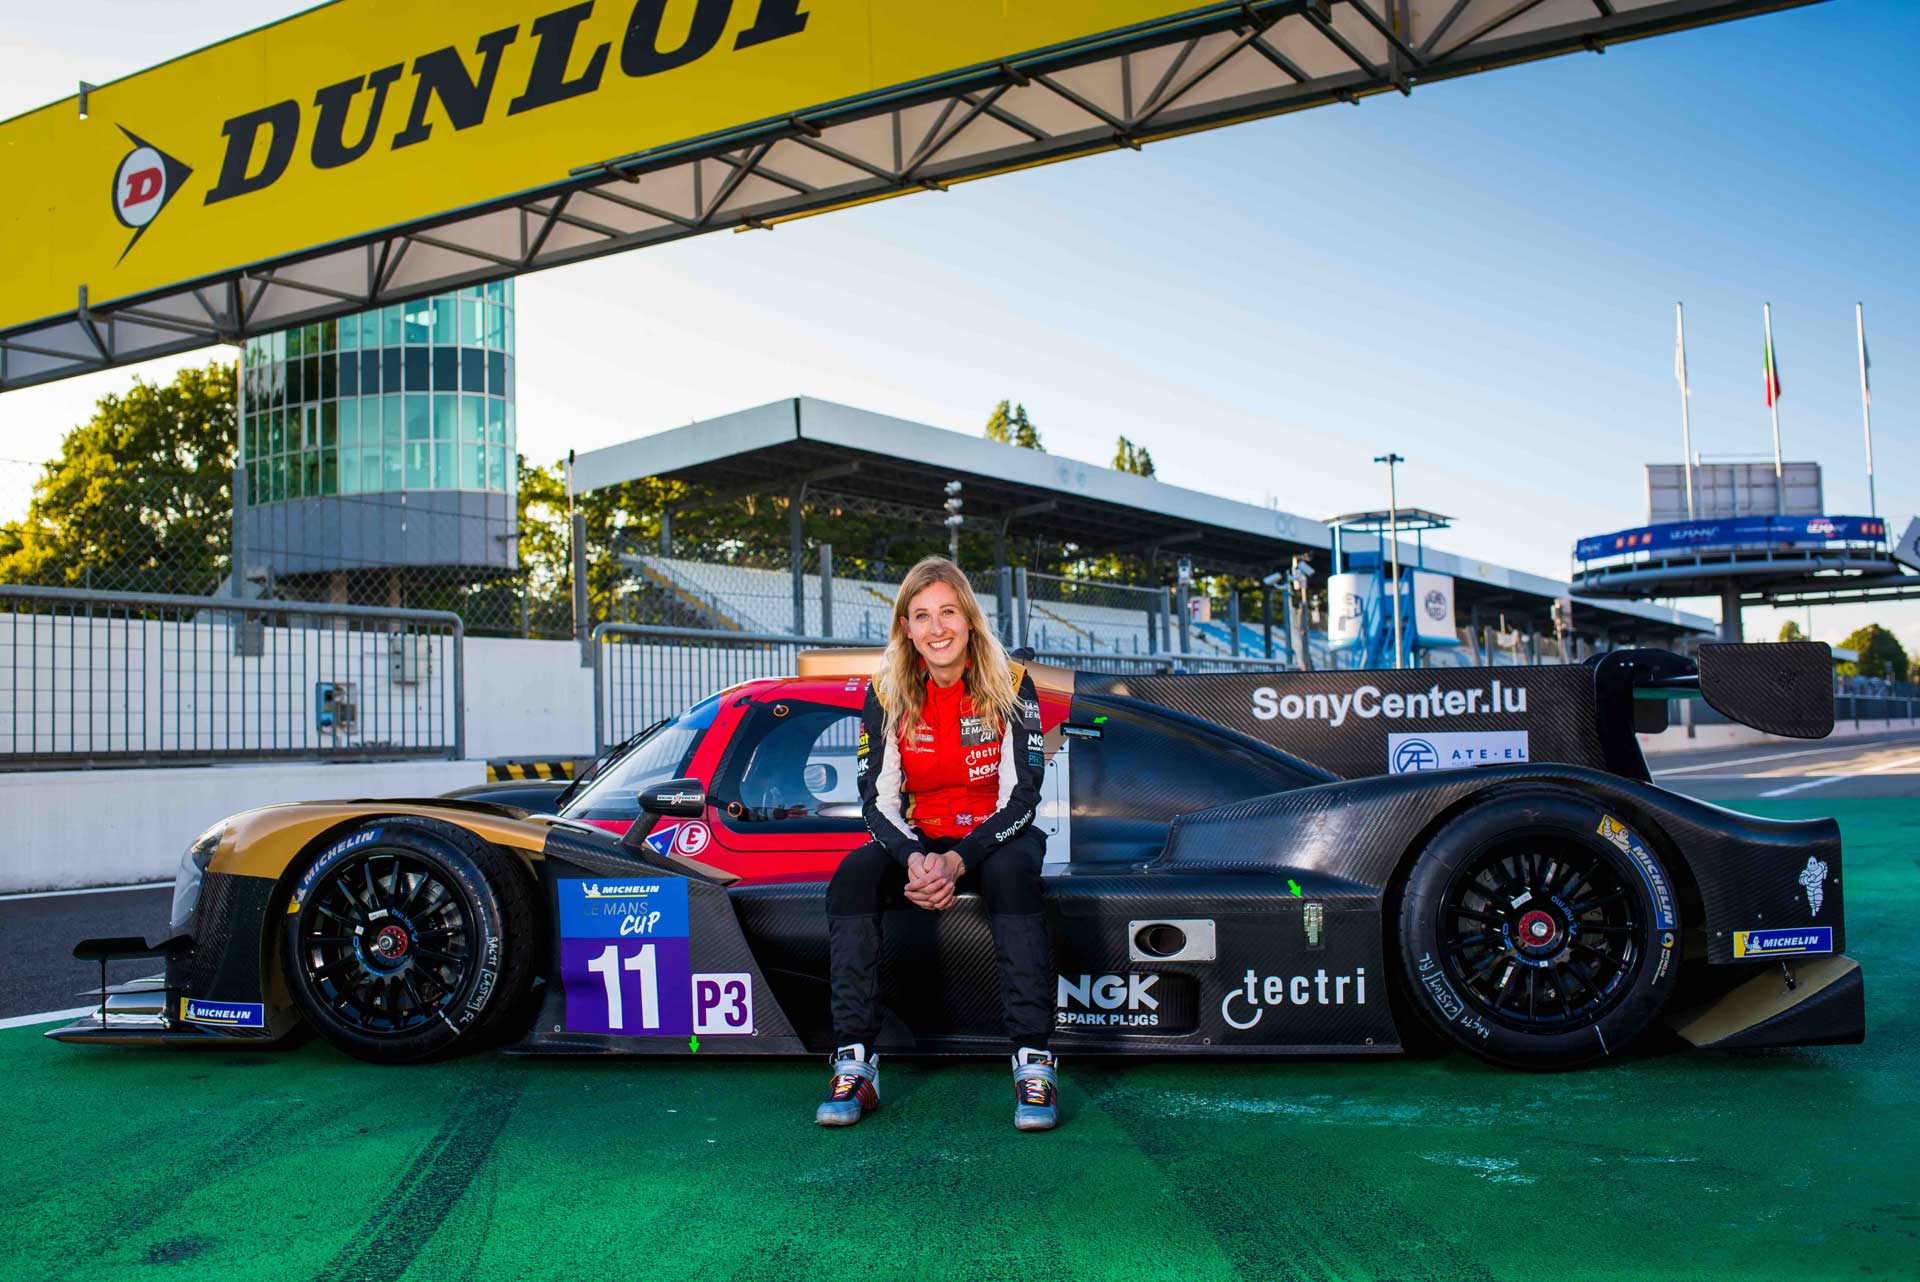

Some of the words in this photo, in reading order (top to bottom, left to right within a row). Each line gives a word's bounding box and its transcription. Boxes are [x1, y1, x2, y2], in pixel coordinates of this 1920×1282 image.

[123, 167, 163, 208] D
[1252, 680, 1527, 727] SonyCenter.lu
[961, 727, 971, 736] LE
[1027, 733, 1044, 747] NG
[968, 760, 999, 779] NGK
[304, 831, 376, 885] MICHELIN
[602, 885, 660, 895] MICHELIN
[1632, 845, 1674, 926] MICHELIN
[583, 901, 601, 916] LE
[603, 901, 649, 916] MANS
[620, 911, 661, 936] CUP
[1762, 935, 1819, 948] MICHELIN
[588, 943, 660, 1029] 11
[1056, 973, 1161, 1011] NGK
[1242, 967, 1367, 1007] tectri
[196, 1008, 251, 1020] MICHELIN
[696, 980, 748, 1028] P3
[1056, 1012, 1106, 1026] SPARK
[1109, 1013, 1159, 1026] PLUGS
